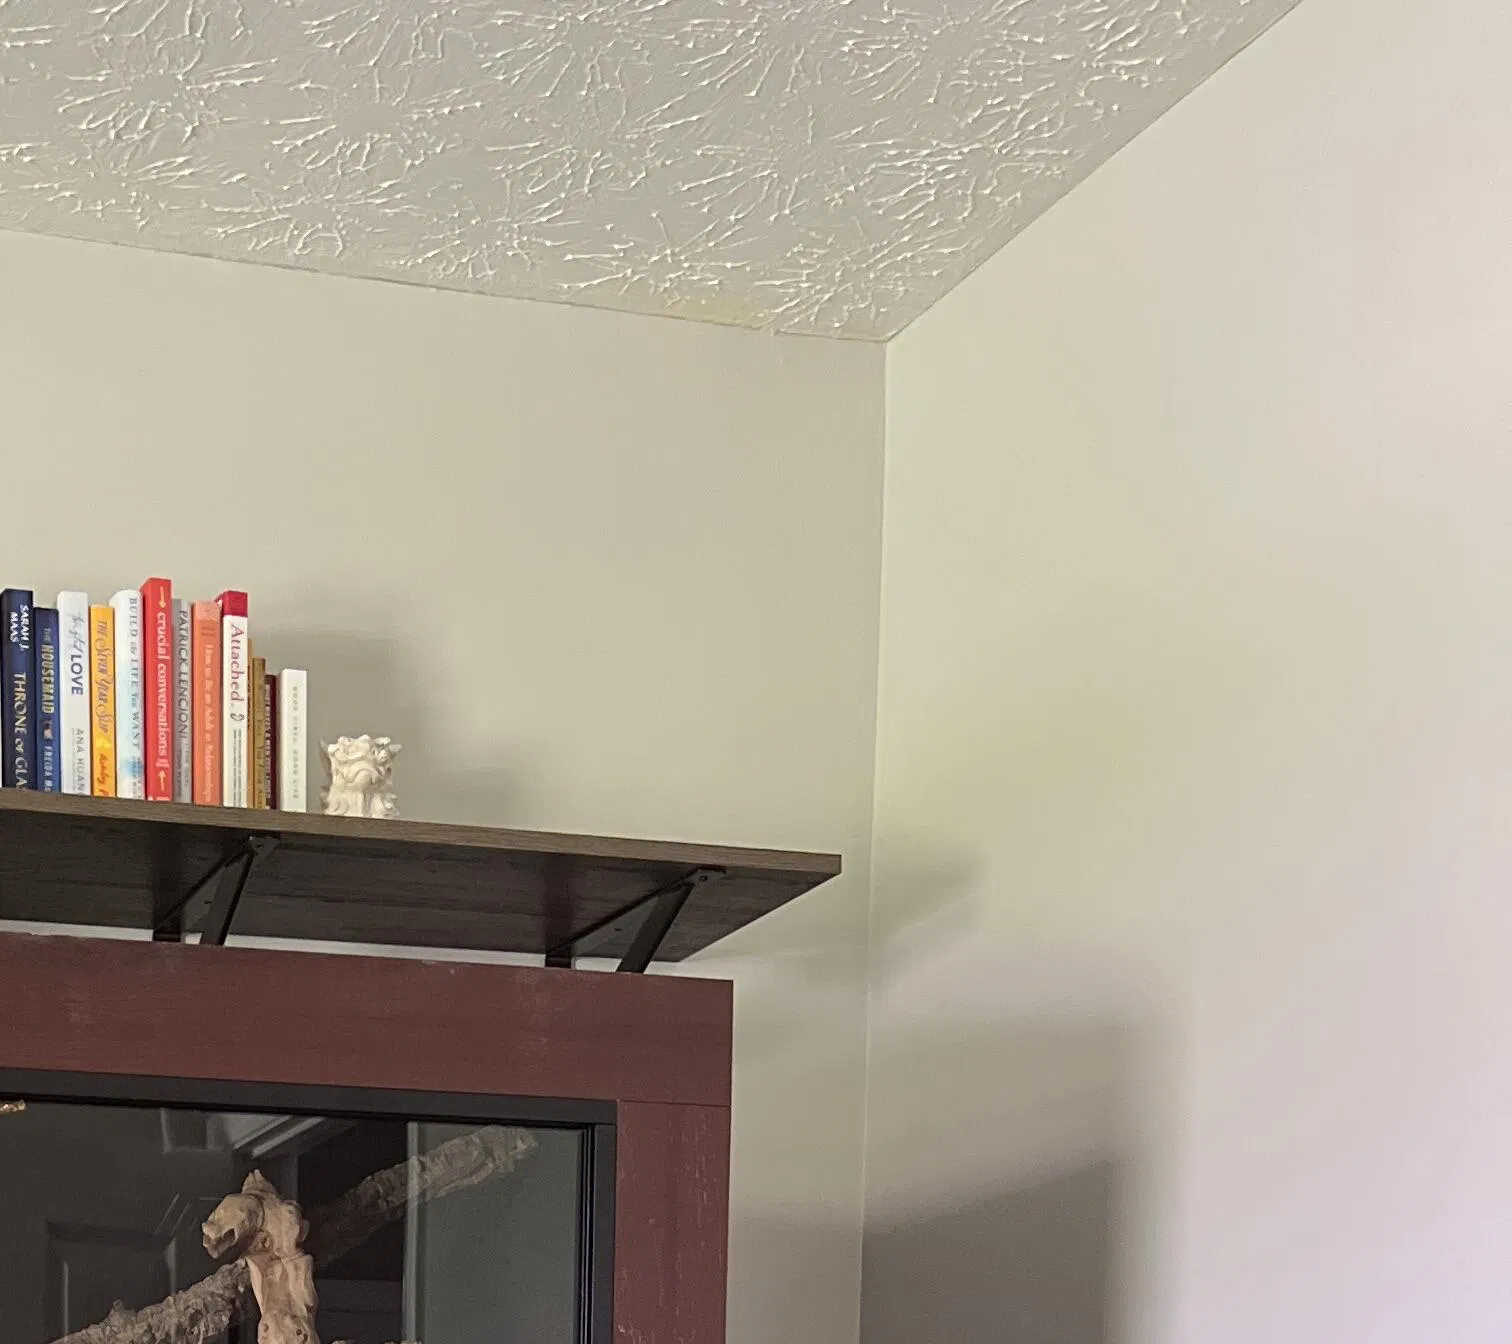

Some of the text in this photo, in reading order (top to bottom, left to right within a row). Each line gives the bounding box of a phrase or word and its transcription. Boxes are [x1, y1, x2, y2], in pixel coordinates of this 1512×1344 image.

[10, 612, 19, 643] MAAS
[20, 604, 30, 641] SARAH
[96, 620, 108, 638] THE
[129, 598, 138, 638] BUILD
[178, 610, 188, 666] PATRICK
[41, 645, 54, 714] HOUSEMAID
[70, 654, 84, 696] LOVE
[130, 658, 138, 688] LIFE
[157, 612, 170, 756] crucial conversations
[14, 672, 28, 735] THRONE
[178, 672, 188, 738] LENCIONI
[76, 728, 84, 752] ANA
[132, 712, 140, 750] WANT
[44, 746, 53, 777] FREIDA
